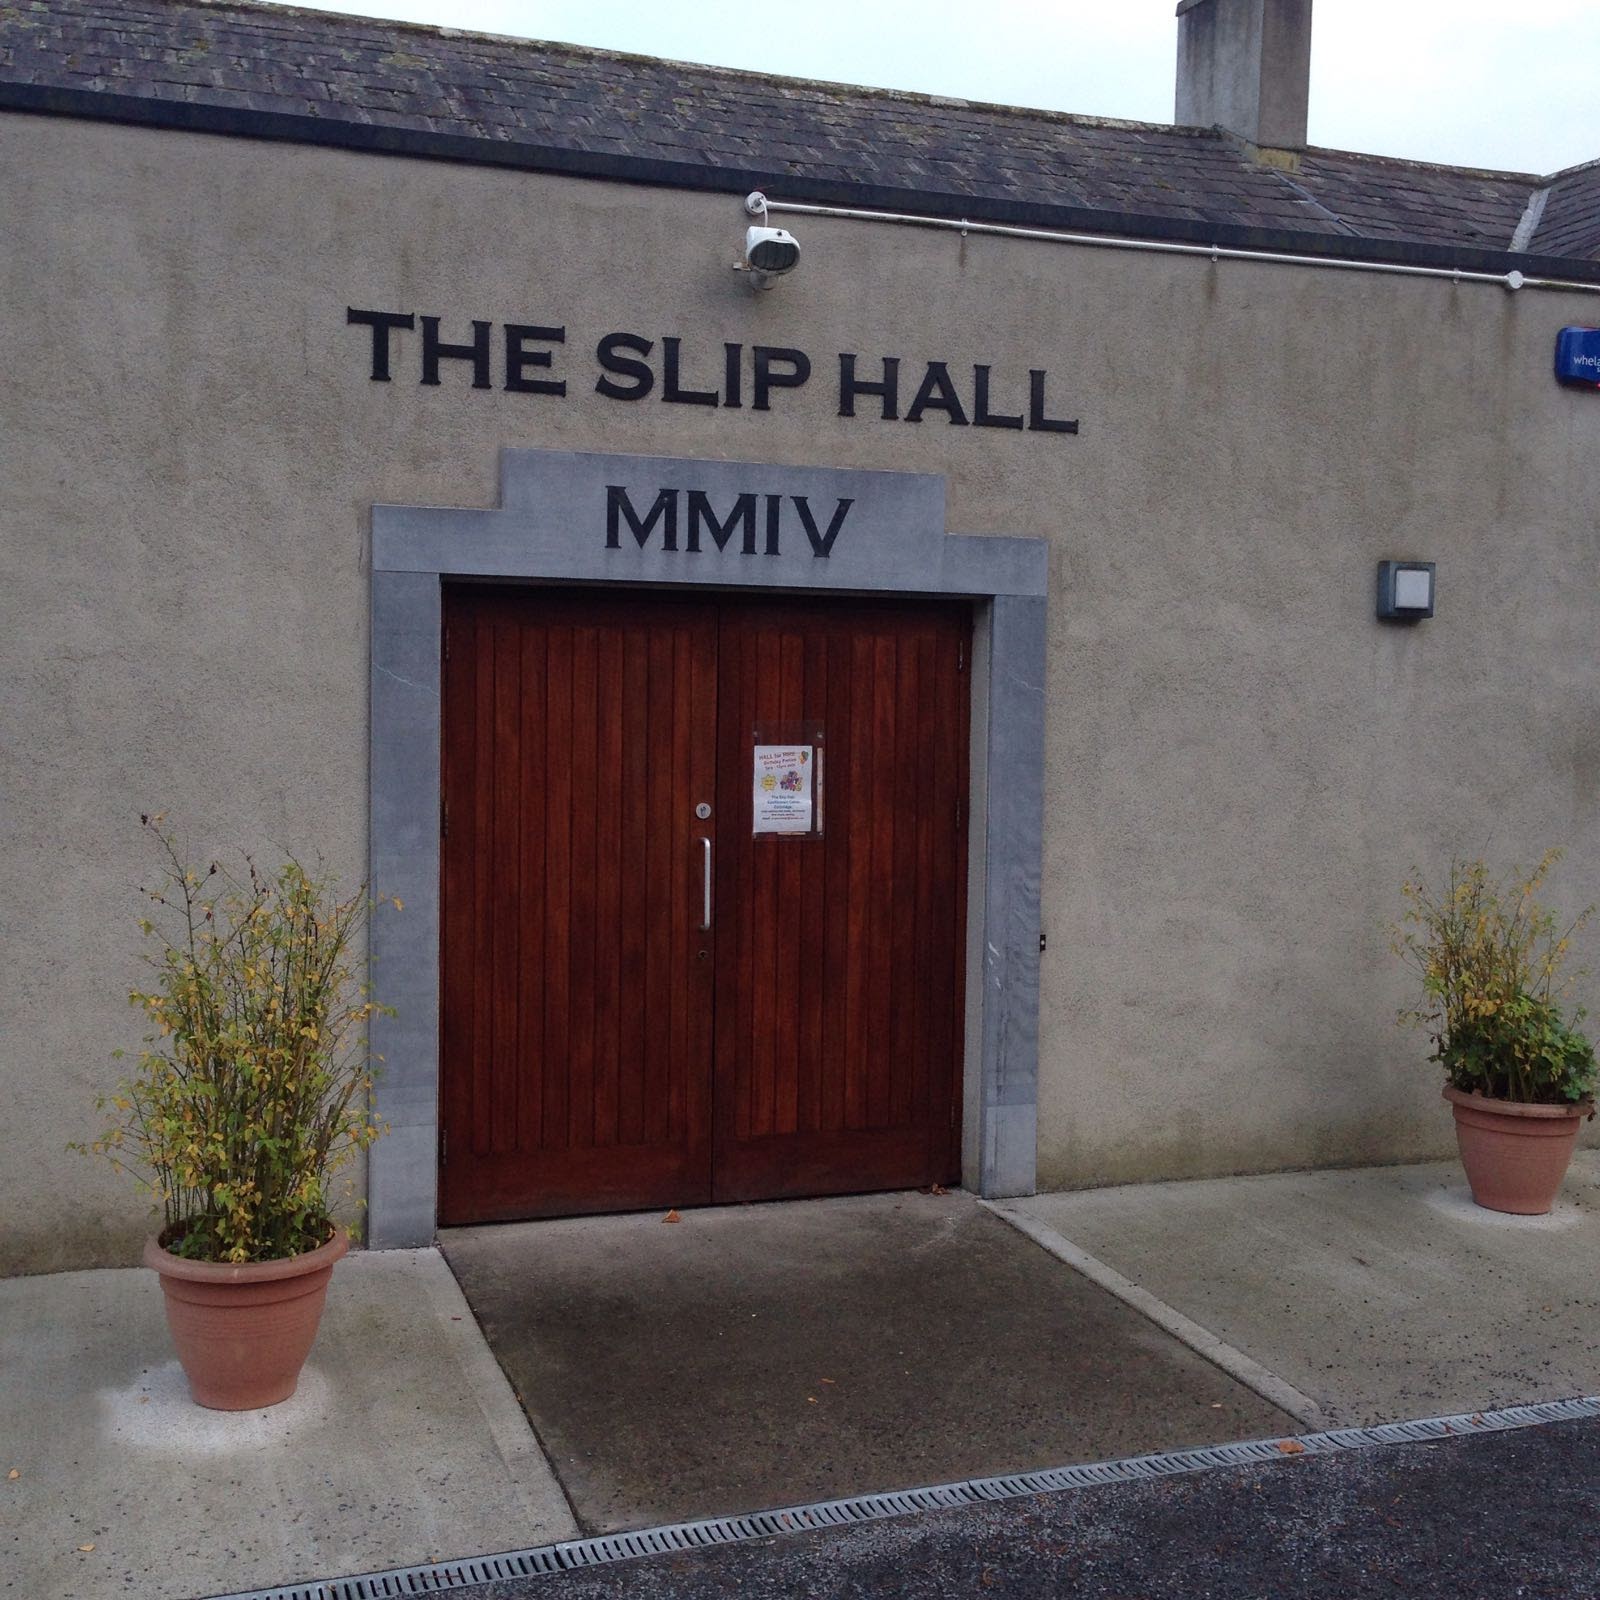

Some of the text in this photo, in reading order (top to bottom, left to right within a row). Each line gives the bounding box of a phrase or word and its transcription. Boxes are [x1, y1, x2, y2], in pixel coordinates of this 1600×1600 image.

[347, 306, 1079, 434] THE SLIP HALL
[605, 485, 855, 558] MMIV
